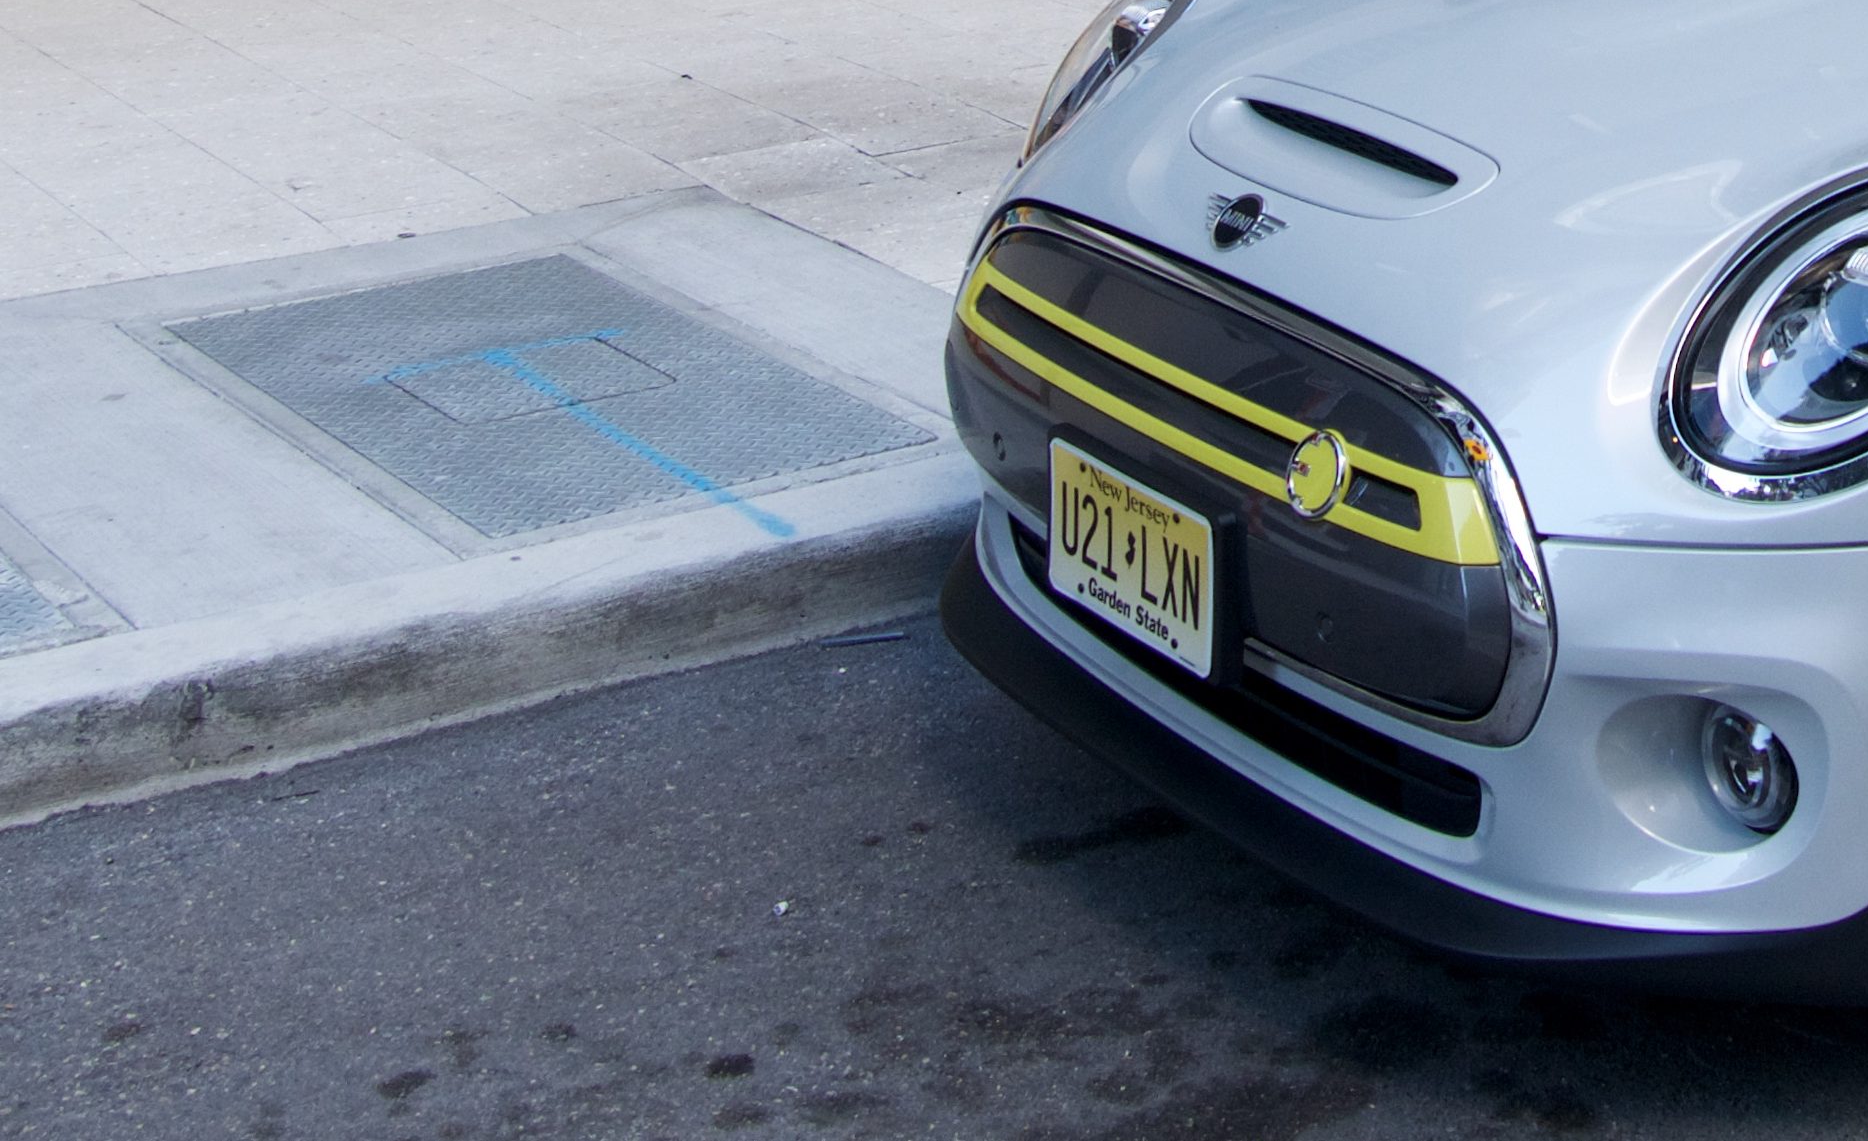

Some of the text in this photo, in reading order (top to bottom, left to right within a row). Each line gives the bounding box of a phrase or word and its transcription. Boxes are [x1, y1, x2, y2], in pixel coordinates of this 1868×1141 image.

[1220, 208, 1254, 232] MINI
[1089, 464, 1171, 534] New Jersey
[1088, 576, 1169, 641] Garden State
